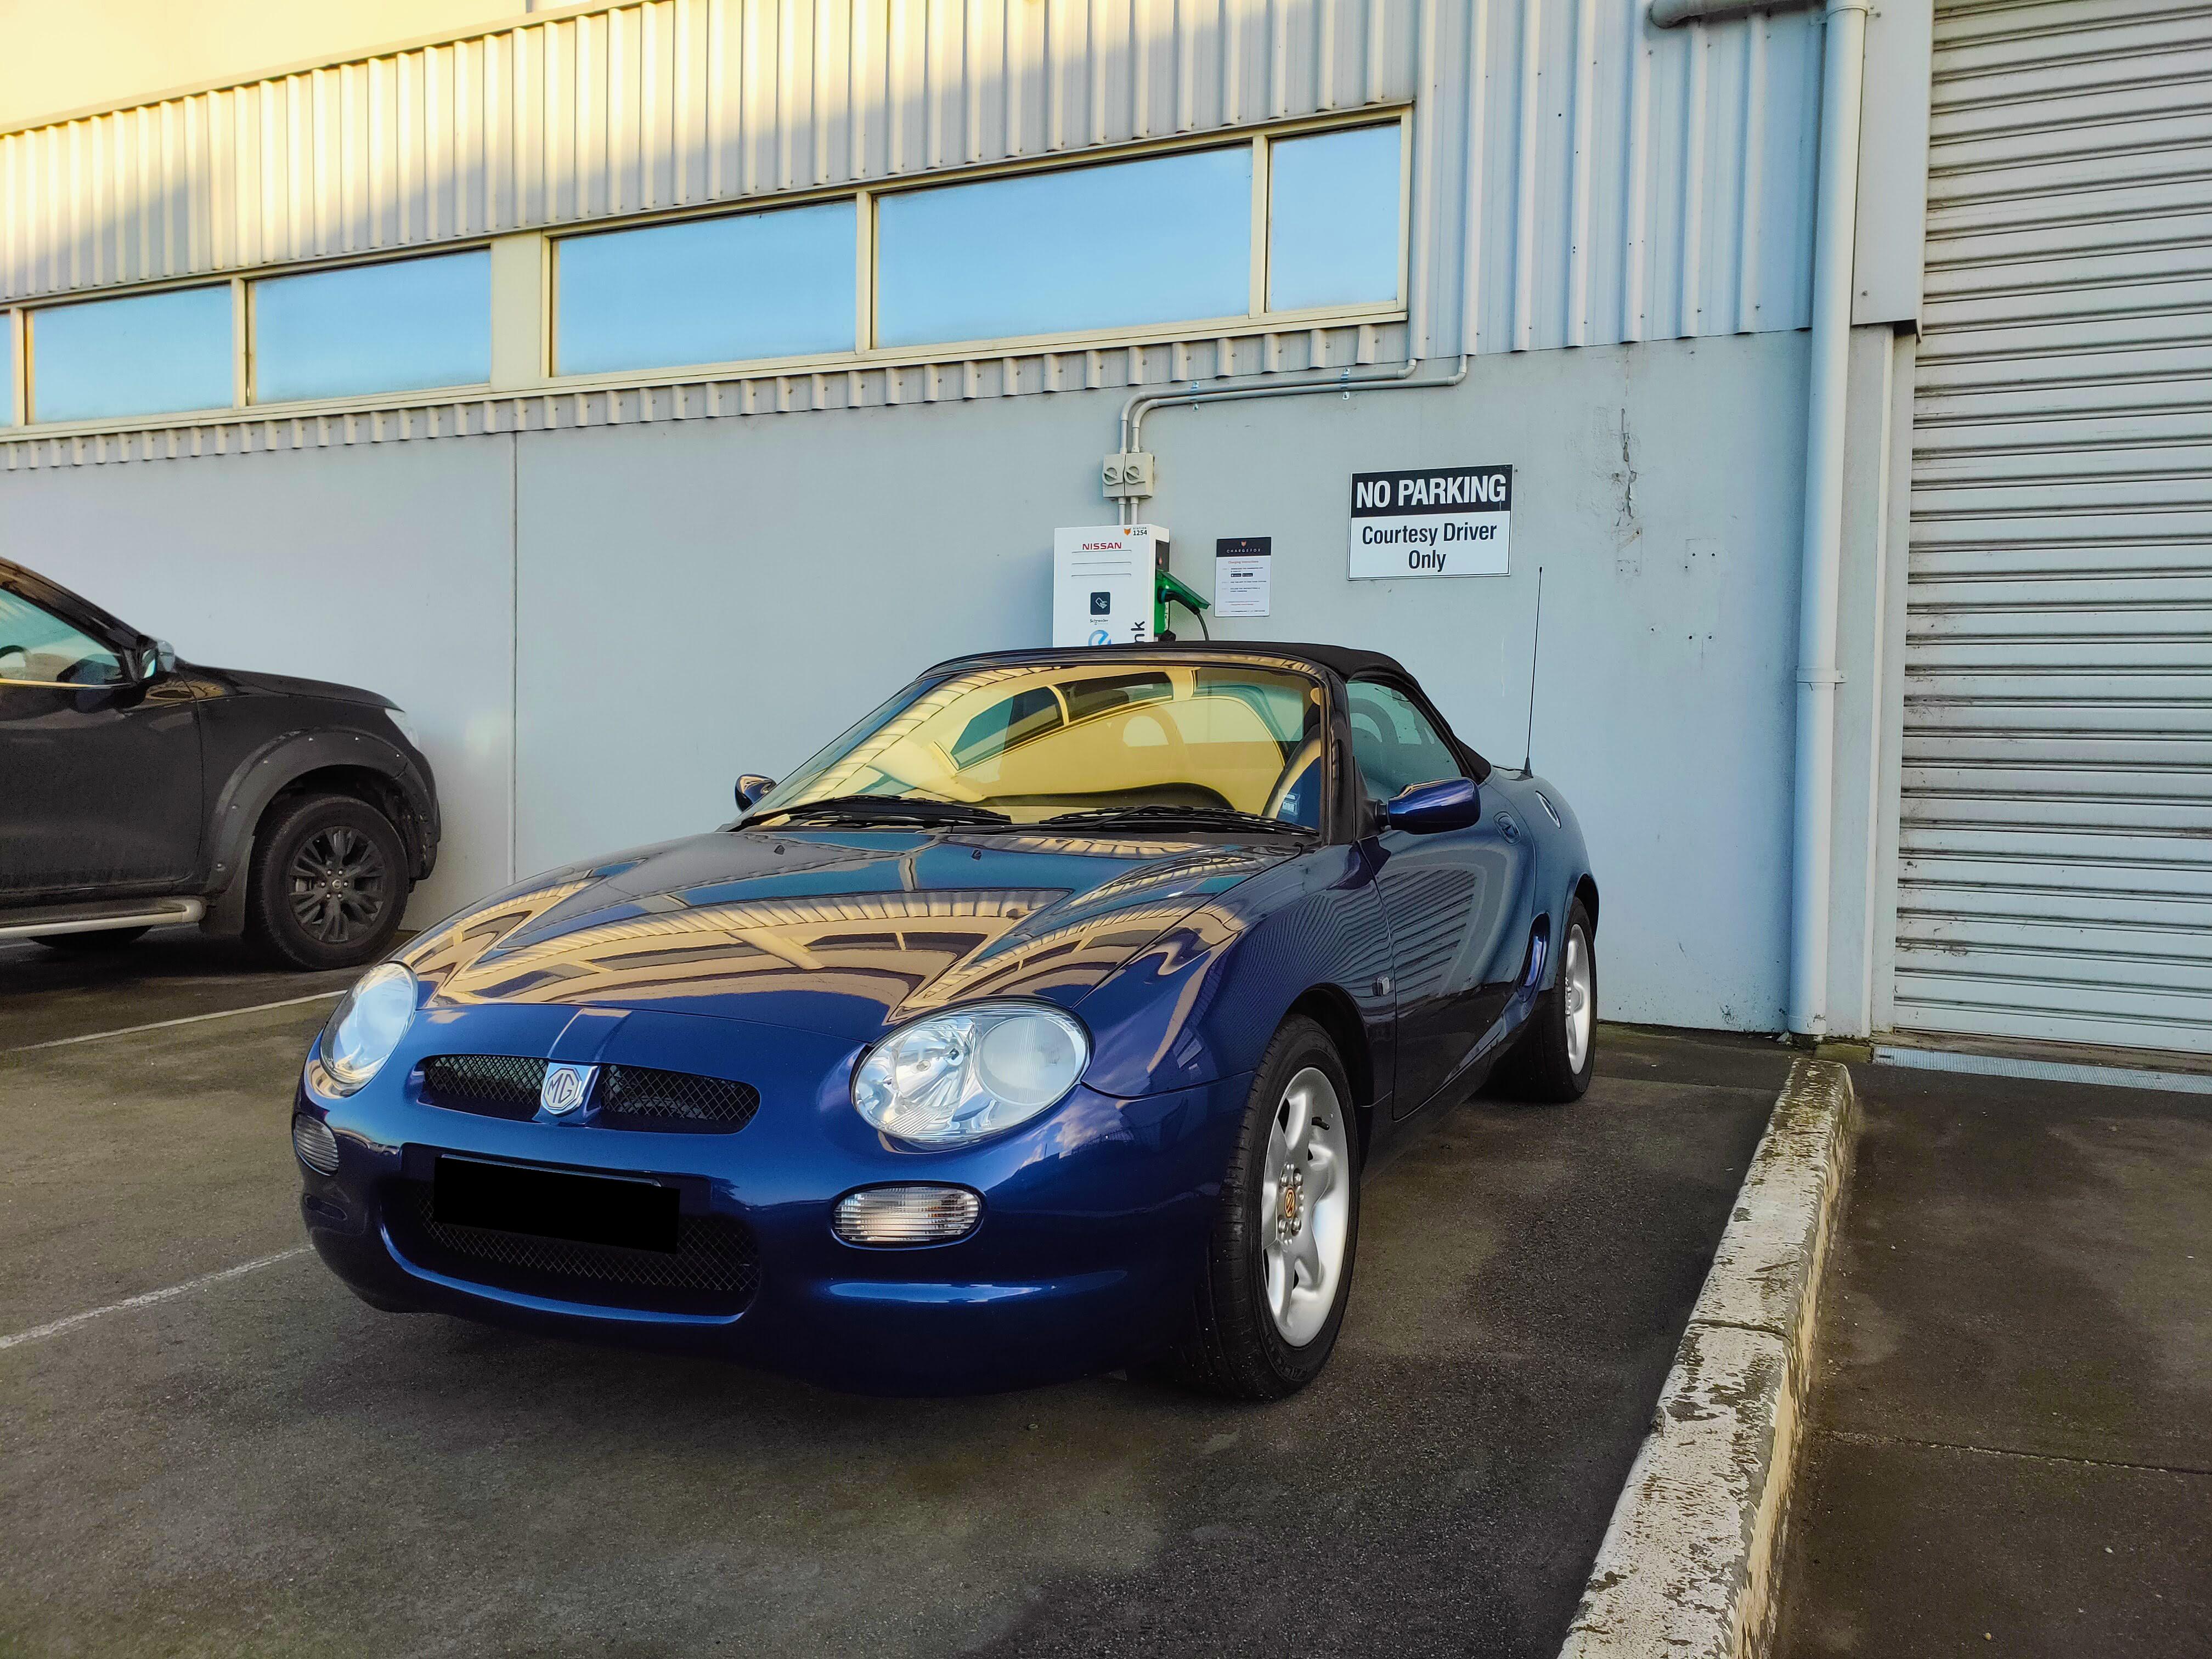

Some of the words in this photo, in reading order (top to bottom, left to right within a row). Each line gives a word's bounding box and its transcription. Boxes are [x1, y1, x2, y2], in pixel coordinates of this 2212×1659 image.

[1356, 480, 1391, 509] NO
[1398, 473, 1506, 506] PARKING
[1082, 542, 1122, 550] NISSAN
[1362, 525, 1438, 546] Courtesy
[1443, 522, 1497, 541] Driver
[1408, 549, 1447, 572] Only
[547, 1073, 574, 1104] MG
